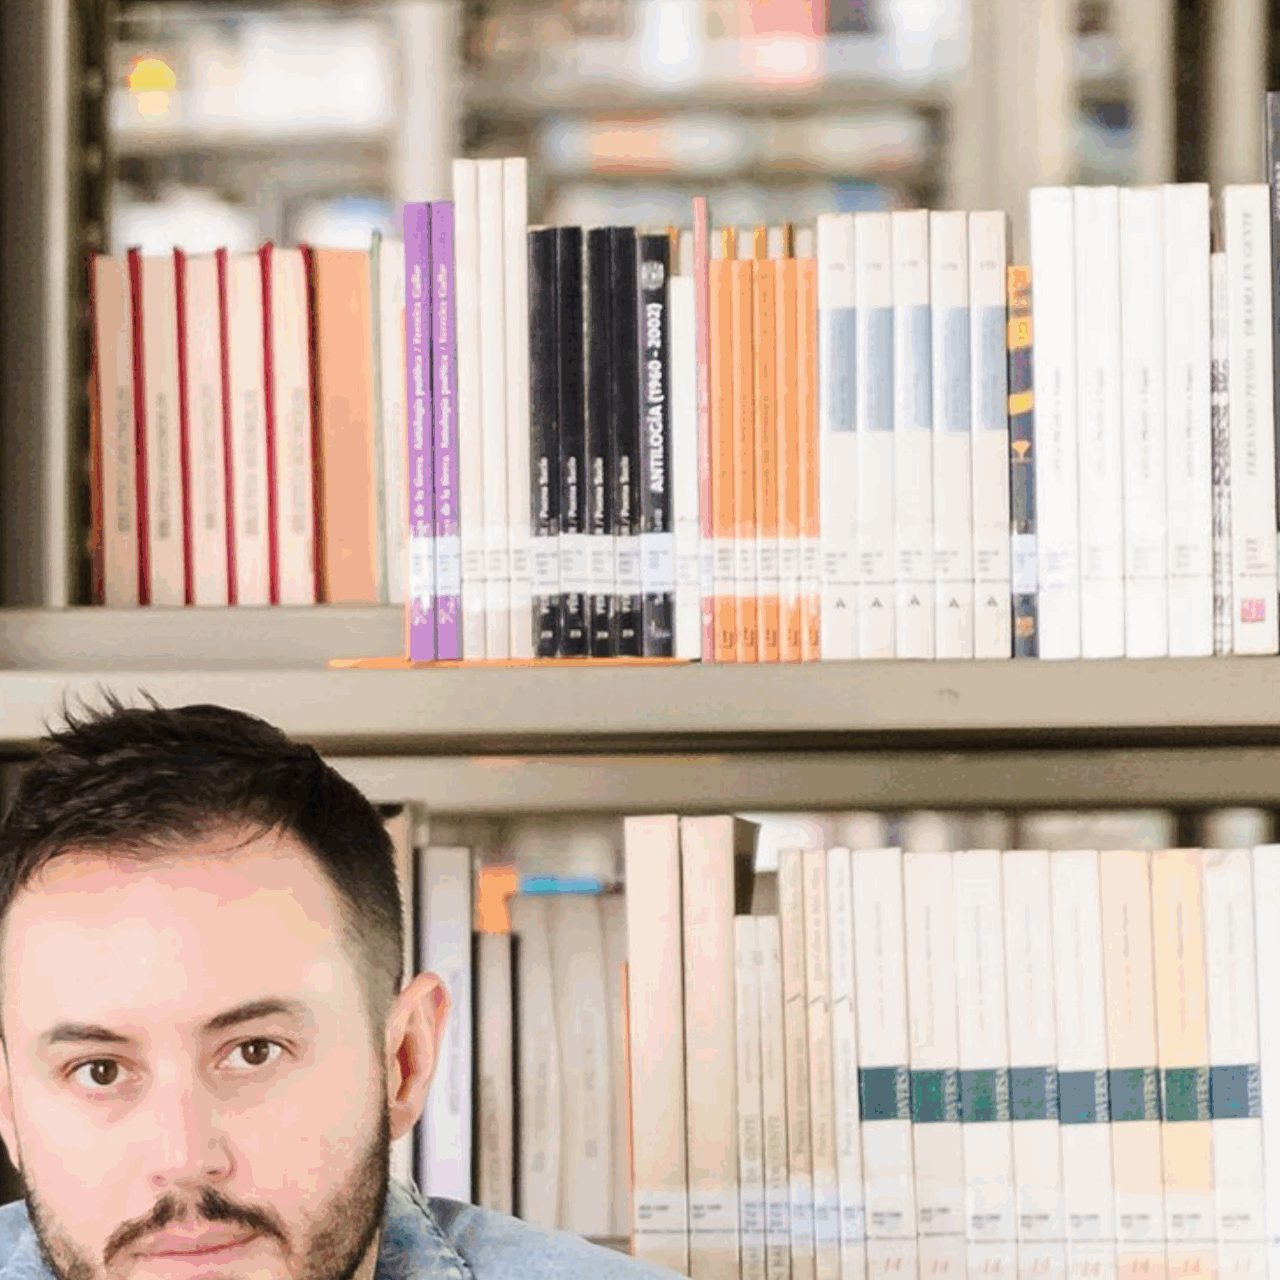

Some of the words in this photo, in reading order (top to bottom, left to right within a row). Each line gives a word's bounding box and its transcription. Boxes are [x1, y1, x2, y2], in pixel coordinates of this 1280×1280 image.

[645, 303, 662, 349] 2002)
[647, 359, 665, 402] (1960
[648, 405, 665, 493] ANTILOGÍA
